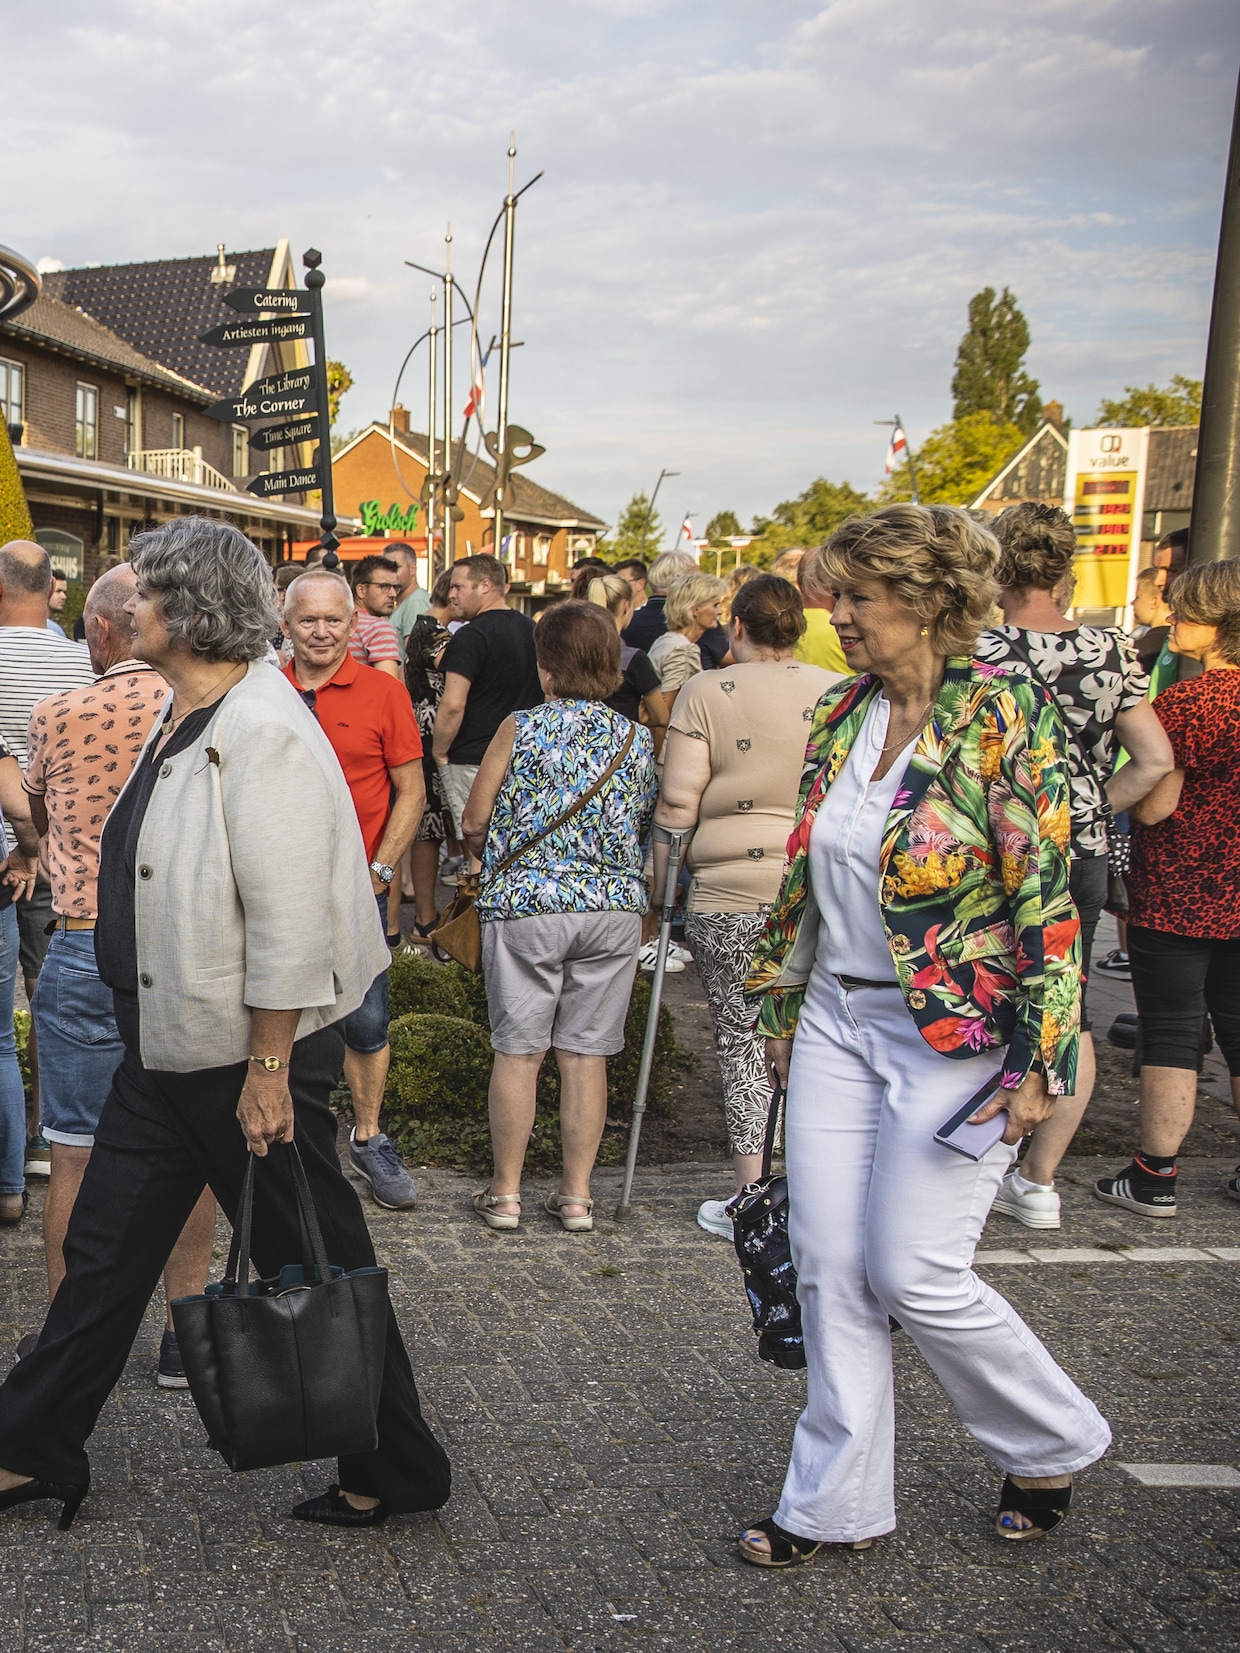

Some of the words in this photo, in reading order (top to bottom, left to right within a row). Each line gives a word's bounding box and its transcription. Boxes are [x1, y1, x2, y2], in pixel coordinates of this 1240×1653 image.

[253, 292, 298, 311] Catering
[222, 326, 269, 340] Artiesten
[271, 323, 305, 338] ingang
[259, 378, 275, 396] The
[277, 373, 310, 390] Library
[232, 398, 258, 418] The
[260, 398, 305, 414] Corner
[263, 428, 283, 444] Time
[284, 423, 312, 442] Square
[1090, 454, 1129, 467] value
[264, 475, 287, 491] Main
[289, 473, 317, 488] Dance
[359, 499, 419, 535] Grolsch
